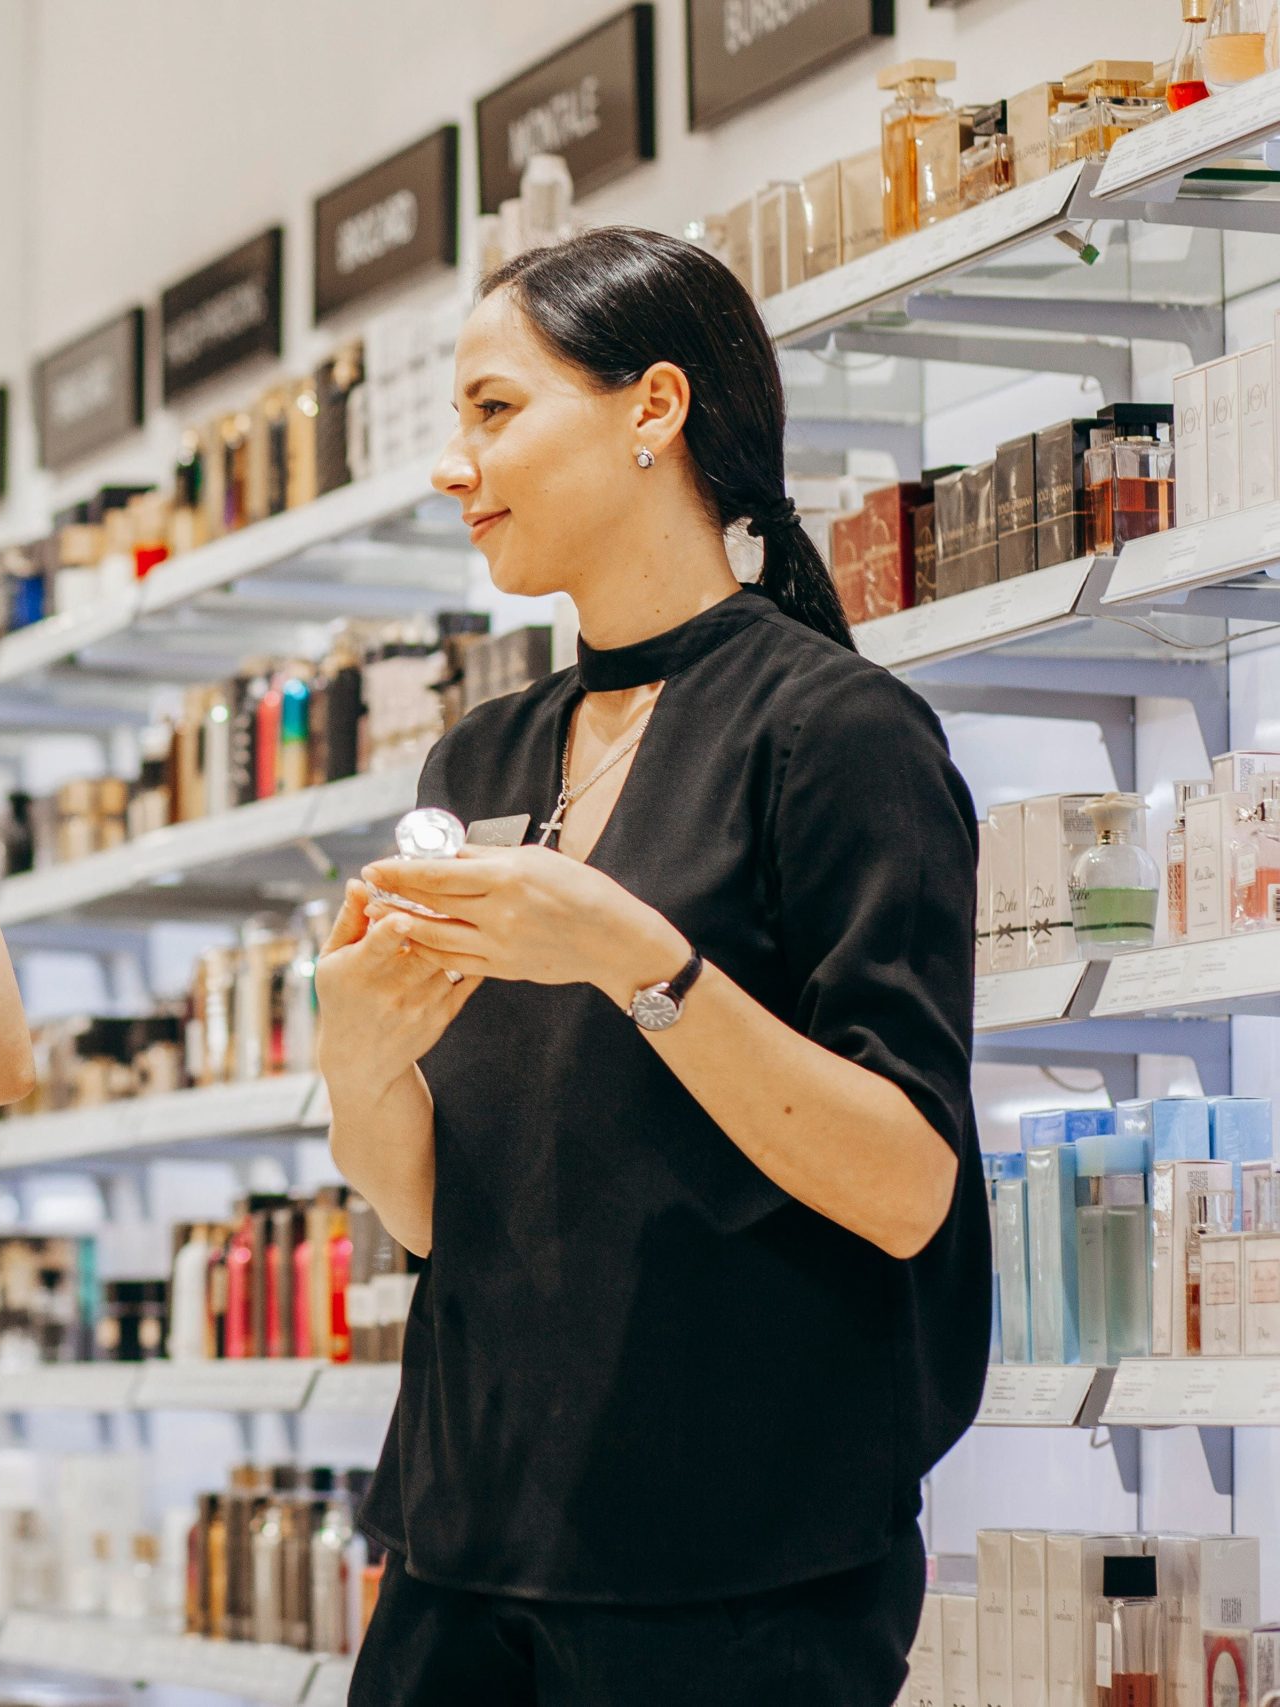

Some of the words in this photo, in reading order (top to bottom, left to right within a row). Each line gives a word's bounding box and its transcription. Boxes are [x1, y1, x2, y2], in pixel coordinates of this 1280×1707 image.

[1209, 393, 1235, 428] JOY
[1244, 382, 1269, 416] JOY
[1177, 403, 1203, 438] JOY
